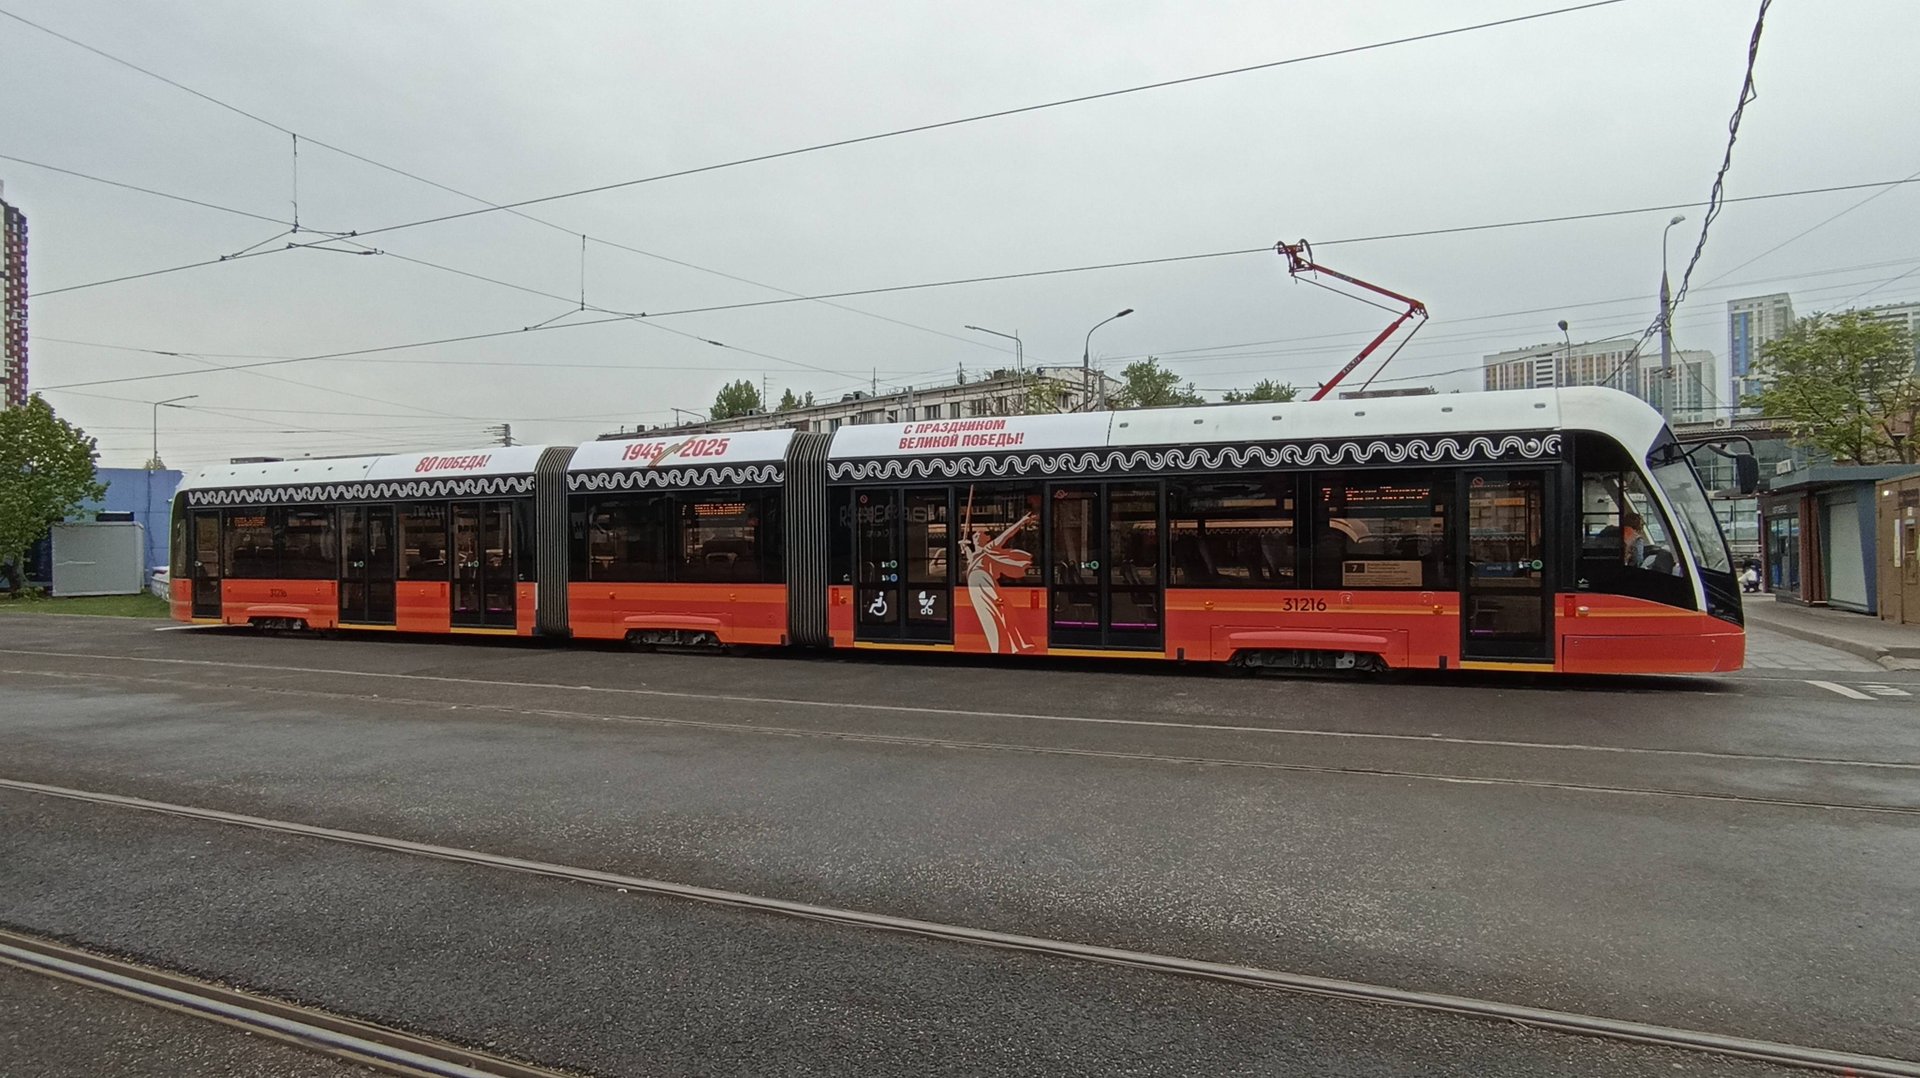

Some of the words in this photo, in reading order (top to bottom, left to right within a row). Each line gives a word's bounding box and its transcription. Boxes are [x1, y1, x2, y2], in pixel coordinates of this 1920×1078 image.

[903, 424, 913, 435] С
[915, 419, 1006, 434] ПРАЗДНИКОМ
[898, 434, 959, 449] ВЕЛИКОЙ
[961, 432, 1024, 447] ПОБЕДЫ!
[621, 442, 666, 461] 1945
[679, 438, 730, 457] 2025
[415, 456, 439, 473] 80
[435, 454, 492, 471] ПОБЕДА!
[1282, 597, 1327, 612] 31216
